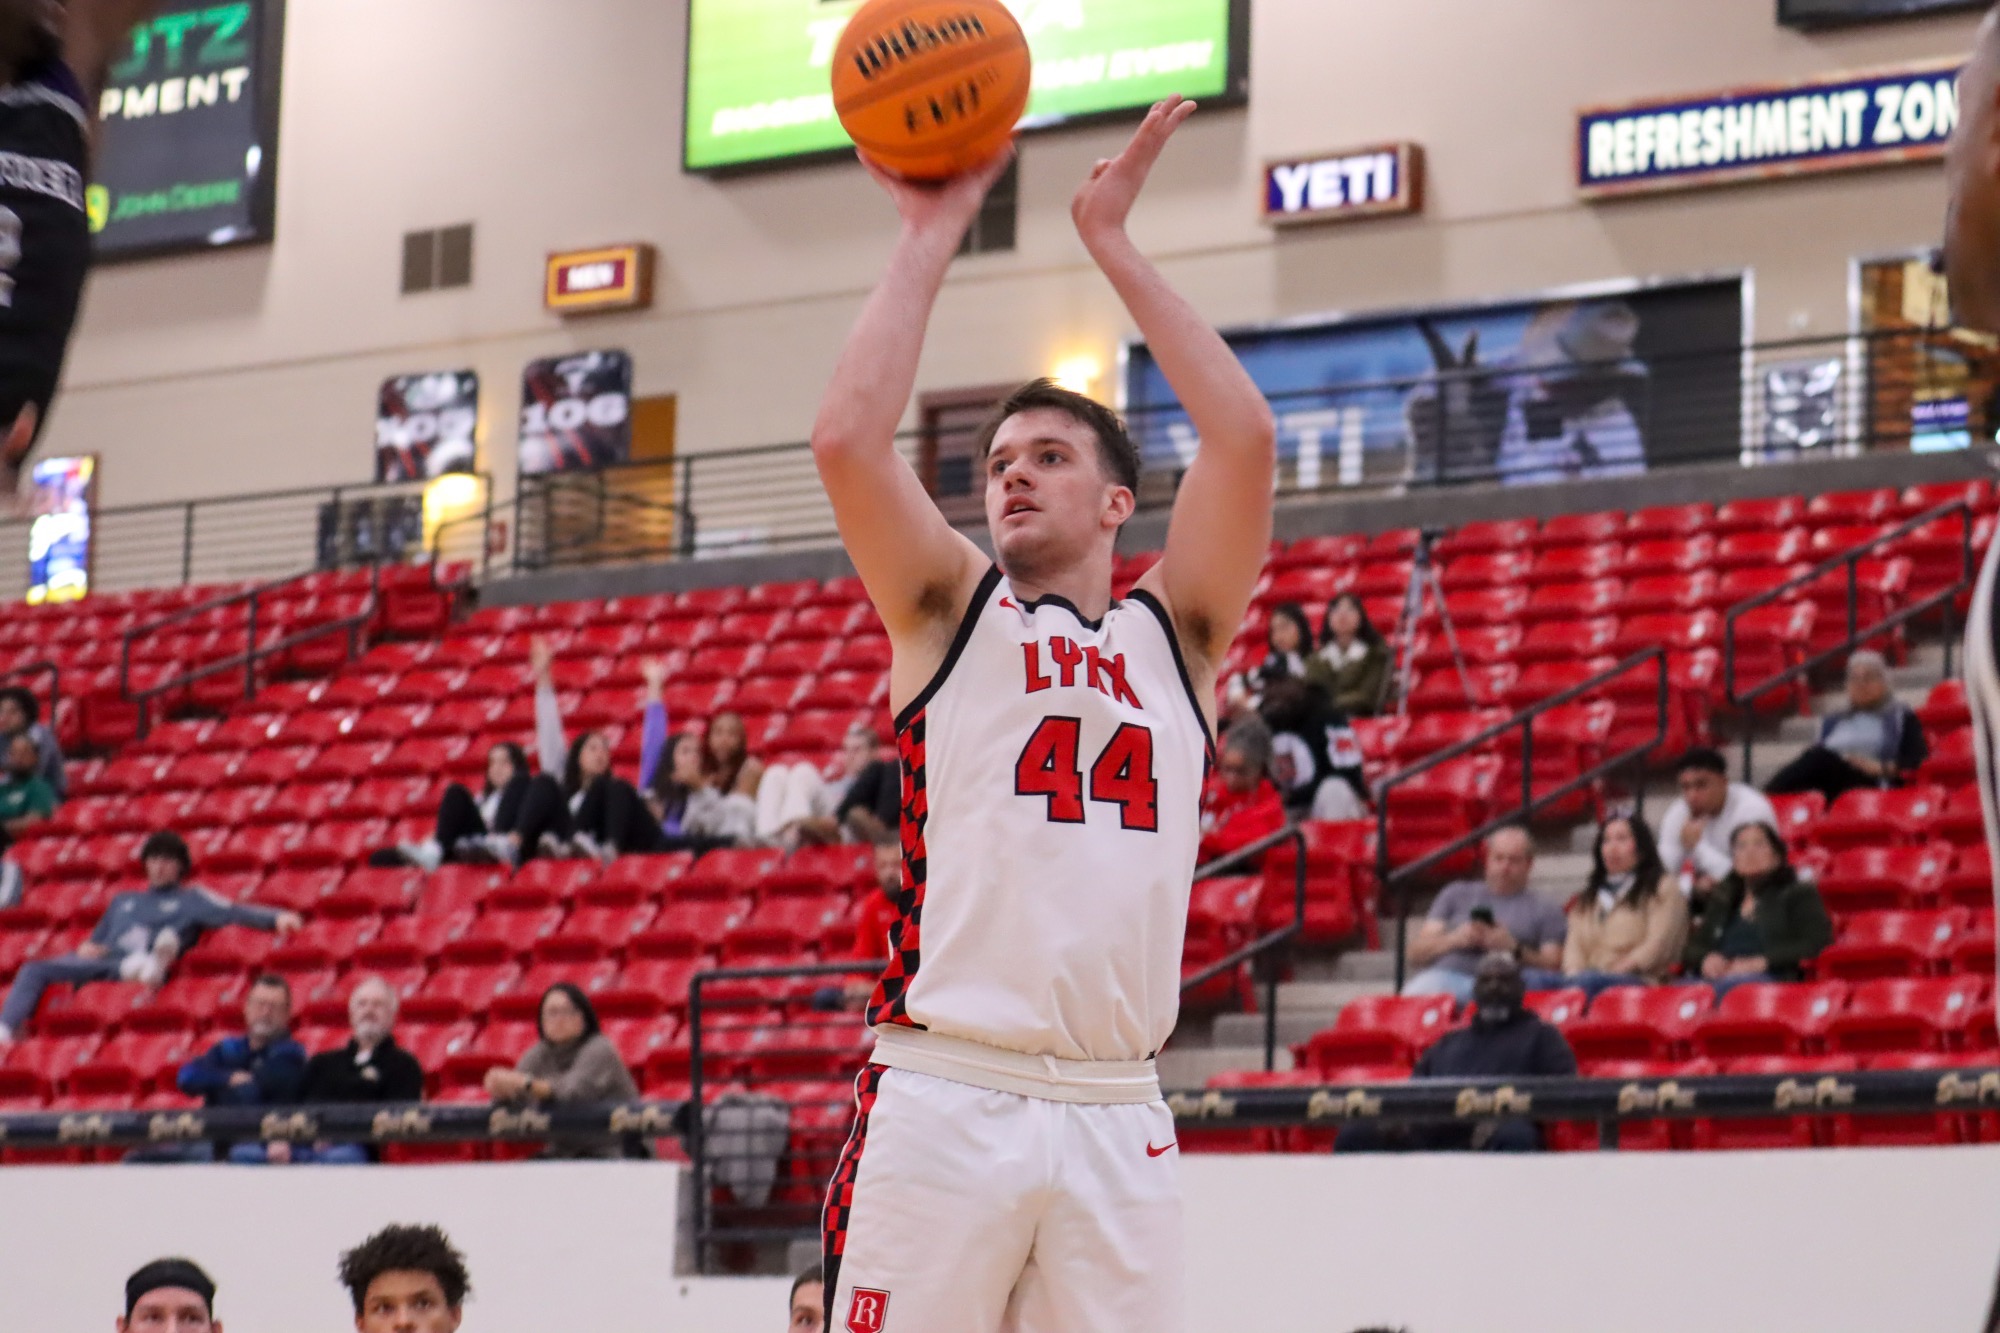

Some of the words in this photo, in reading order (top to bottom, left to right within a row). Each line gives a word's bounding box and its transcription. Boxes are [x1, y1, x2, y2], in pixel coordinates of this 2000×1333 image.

[1588, 88, 1868, 178] REFRESHMENT
[1273, 152, 1393, 213] YETI
[1014, 714, 1158, 833] 44
[852, 1294, 878, 1329] R
